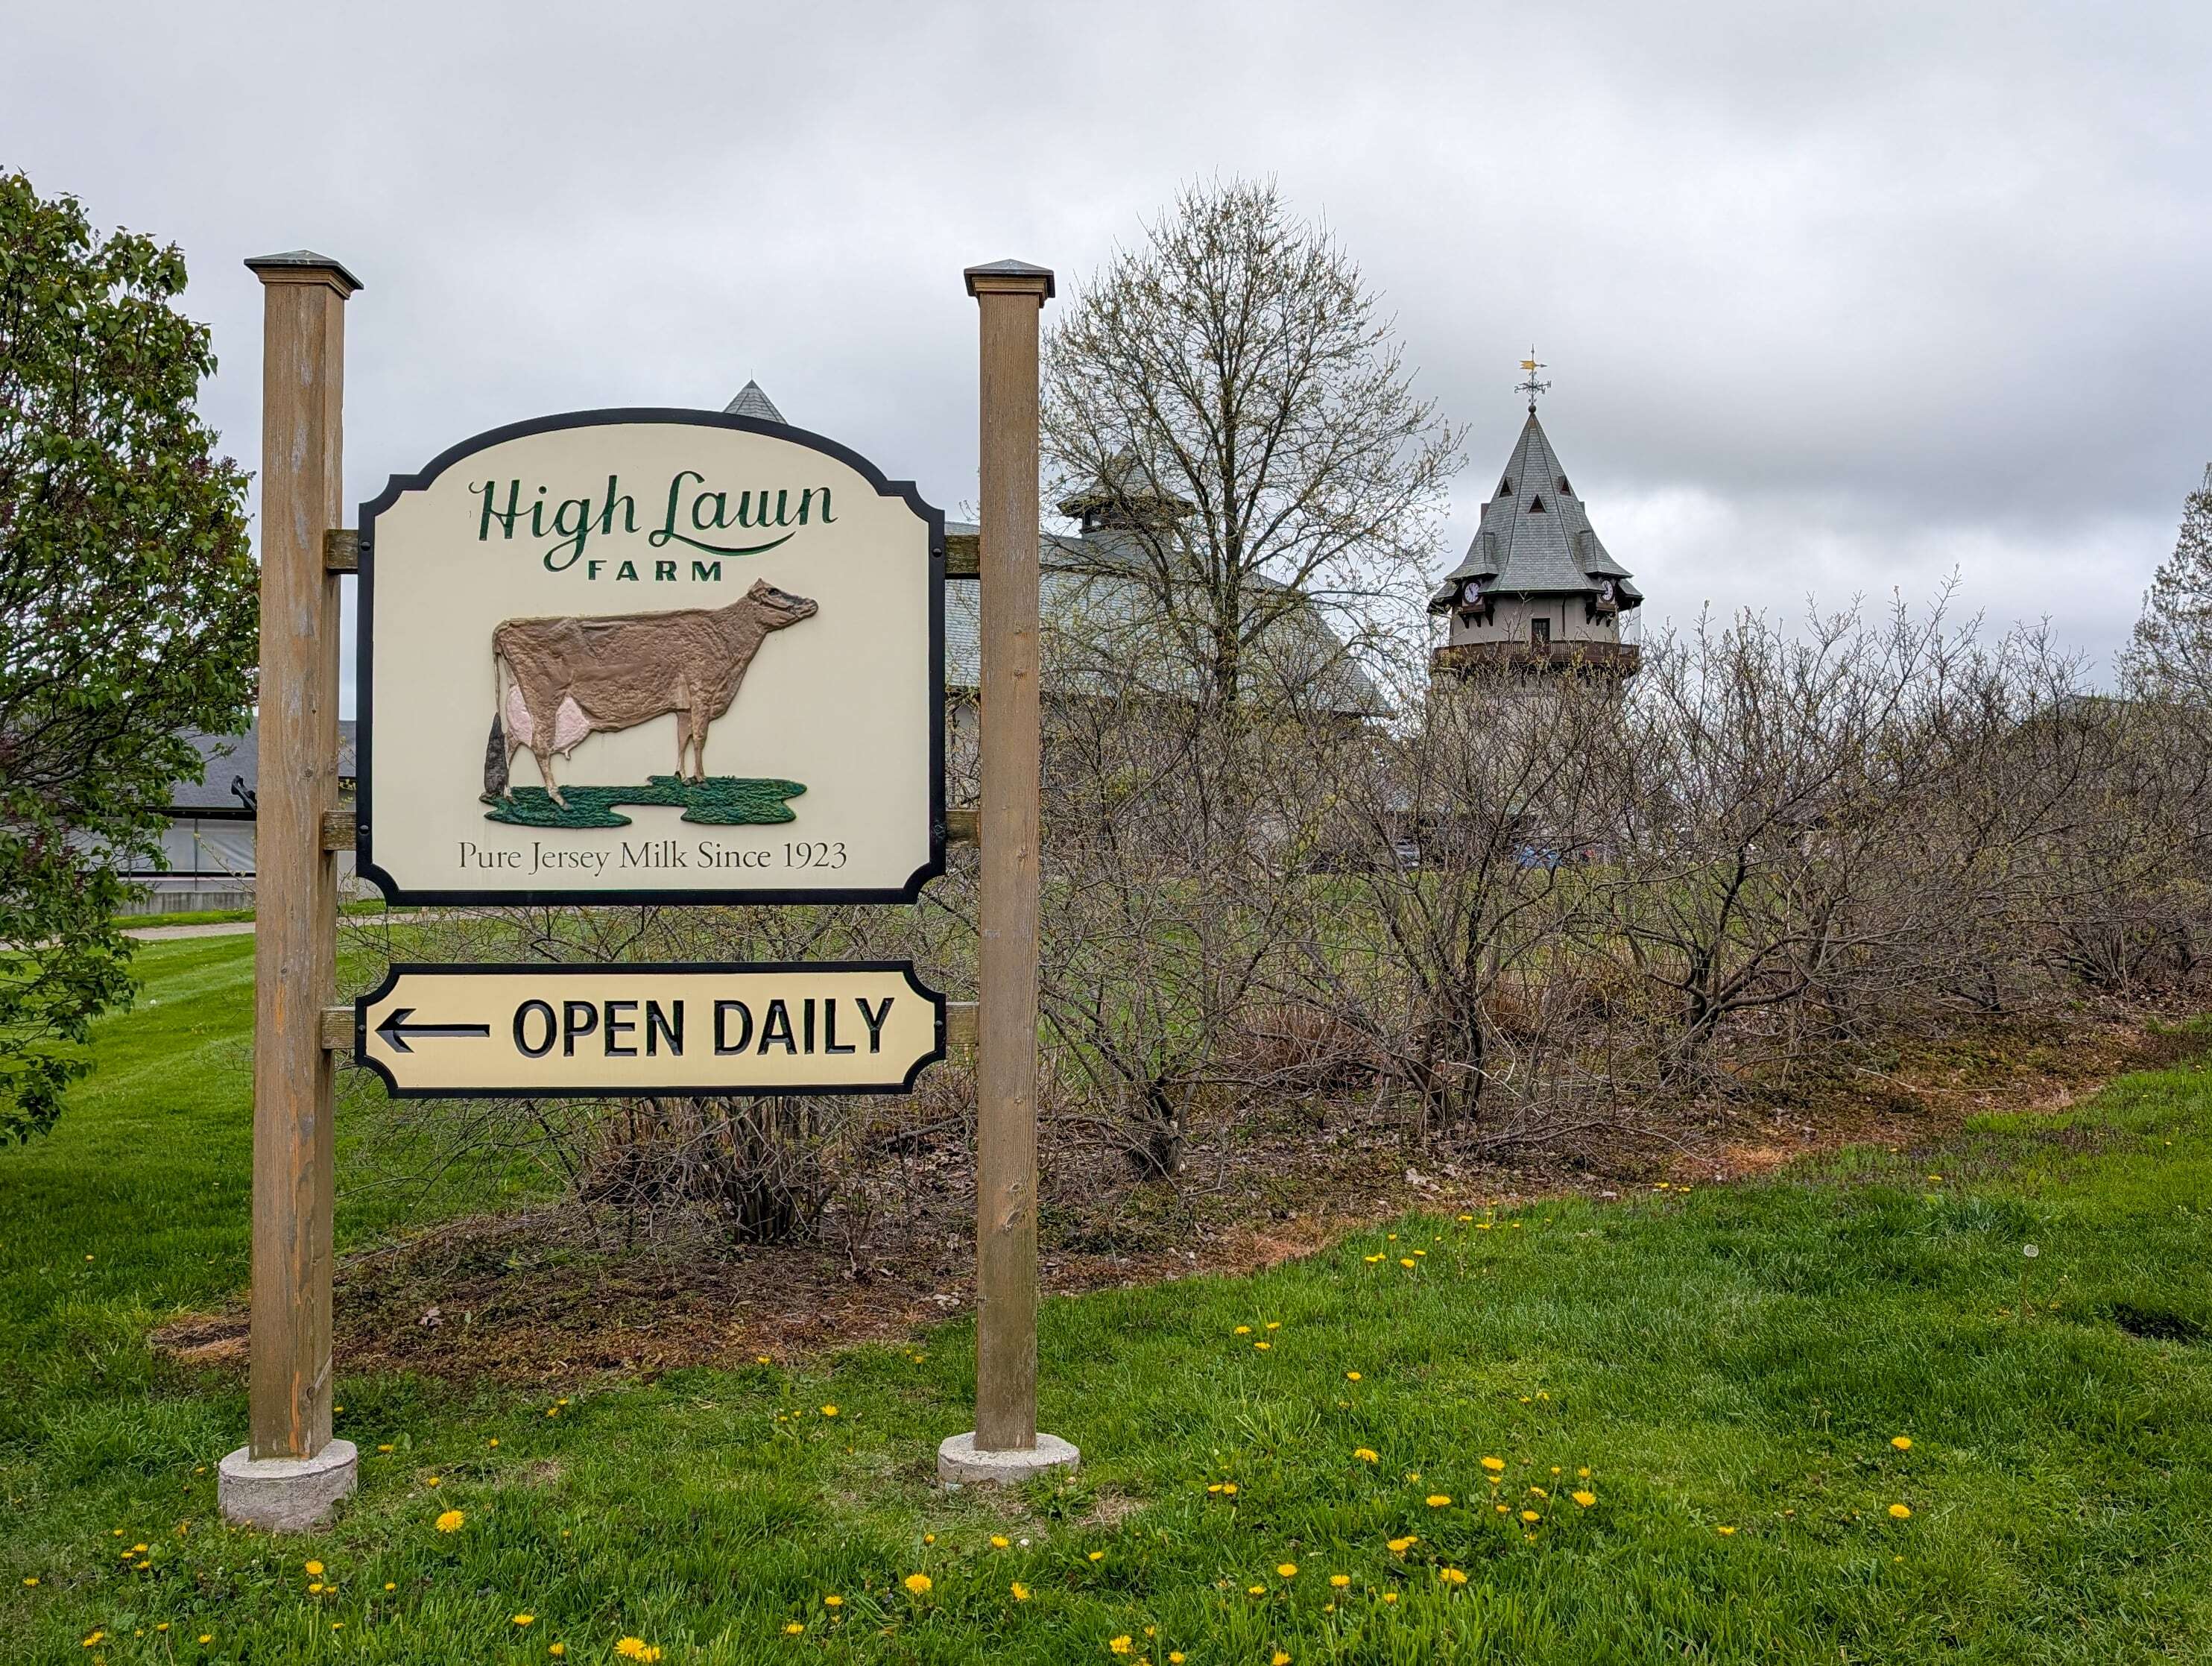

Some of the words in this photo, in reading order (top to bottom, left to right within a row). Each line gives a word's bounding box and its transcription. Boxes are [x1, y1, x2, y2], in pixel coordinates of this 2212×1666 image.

[469, 475, 642, 572] High
[648, 471, 838, 556] Lawn
[588, 560, 721, 581] FARM
[458, 842, 521, 869] Pure
[528, 842, 610, 877] Jersey
[619, 841, 689, 869] Milk
[698, 842, 771, 868] Since
[784, 842, 847, 870] 1923
[513, 1000, 683, 1058] OPEN
[714, 997, 895, 1056] DAILY
